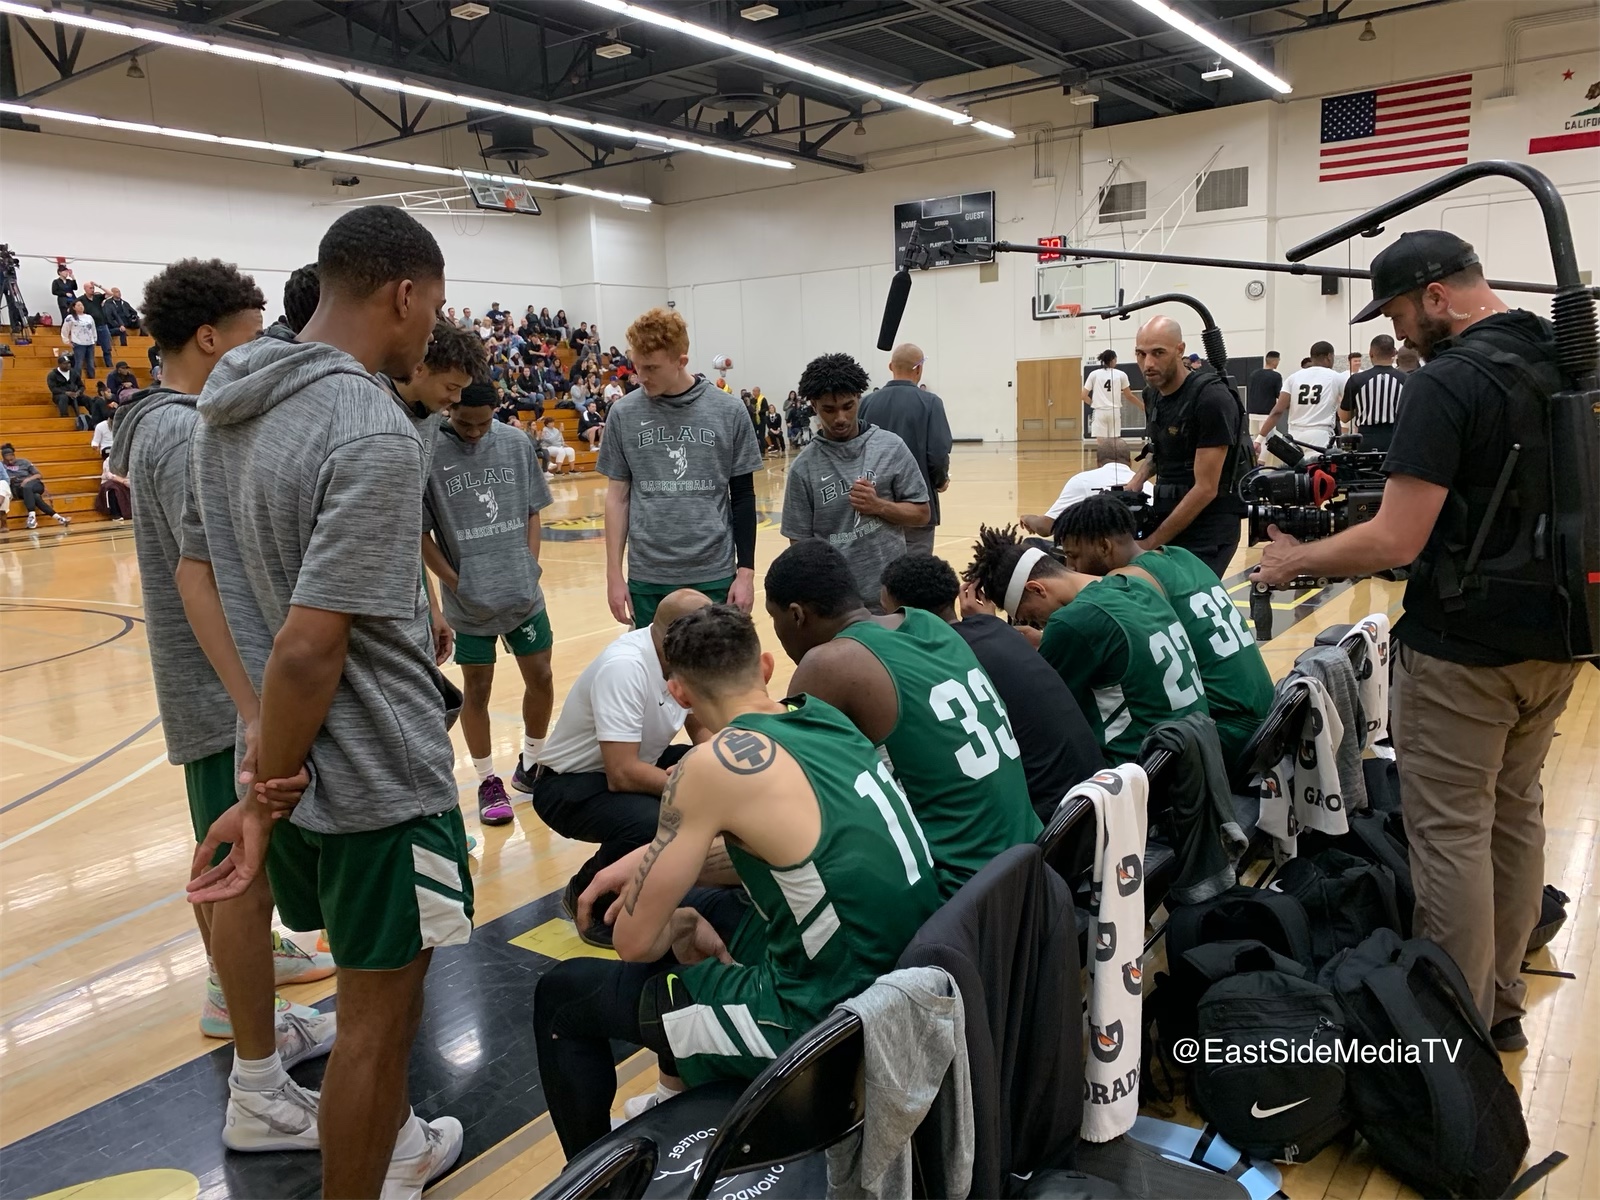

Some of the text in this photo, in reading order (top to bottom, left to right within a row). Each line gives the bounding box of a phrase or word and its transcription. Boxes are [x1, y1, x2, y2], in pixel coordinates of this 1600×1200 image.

[901, 220, 917, 229] HOME
[965, 211, 985, 221] GUEST
[1103, 379, 1112, 392] 4
[1297, 383, 1323, 405] 23
[638, 425, 716, 449] ELAC
[445, 467, 516, 498] ELAC
[639, 480, 716, 492] BASKETBALL
[820, 469, 877, 505] ELC
[456, 517, 525, 541] BASKETBALL
[1189, 585, 1255, 658] 32
[1148, 620, 1205, 711] 23
[928, 667, 1021, 780] 33
[853, 760, 935, 886] 11
[668, 1127, 718, 1159] COLLEGE
